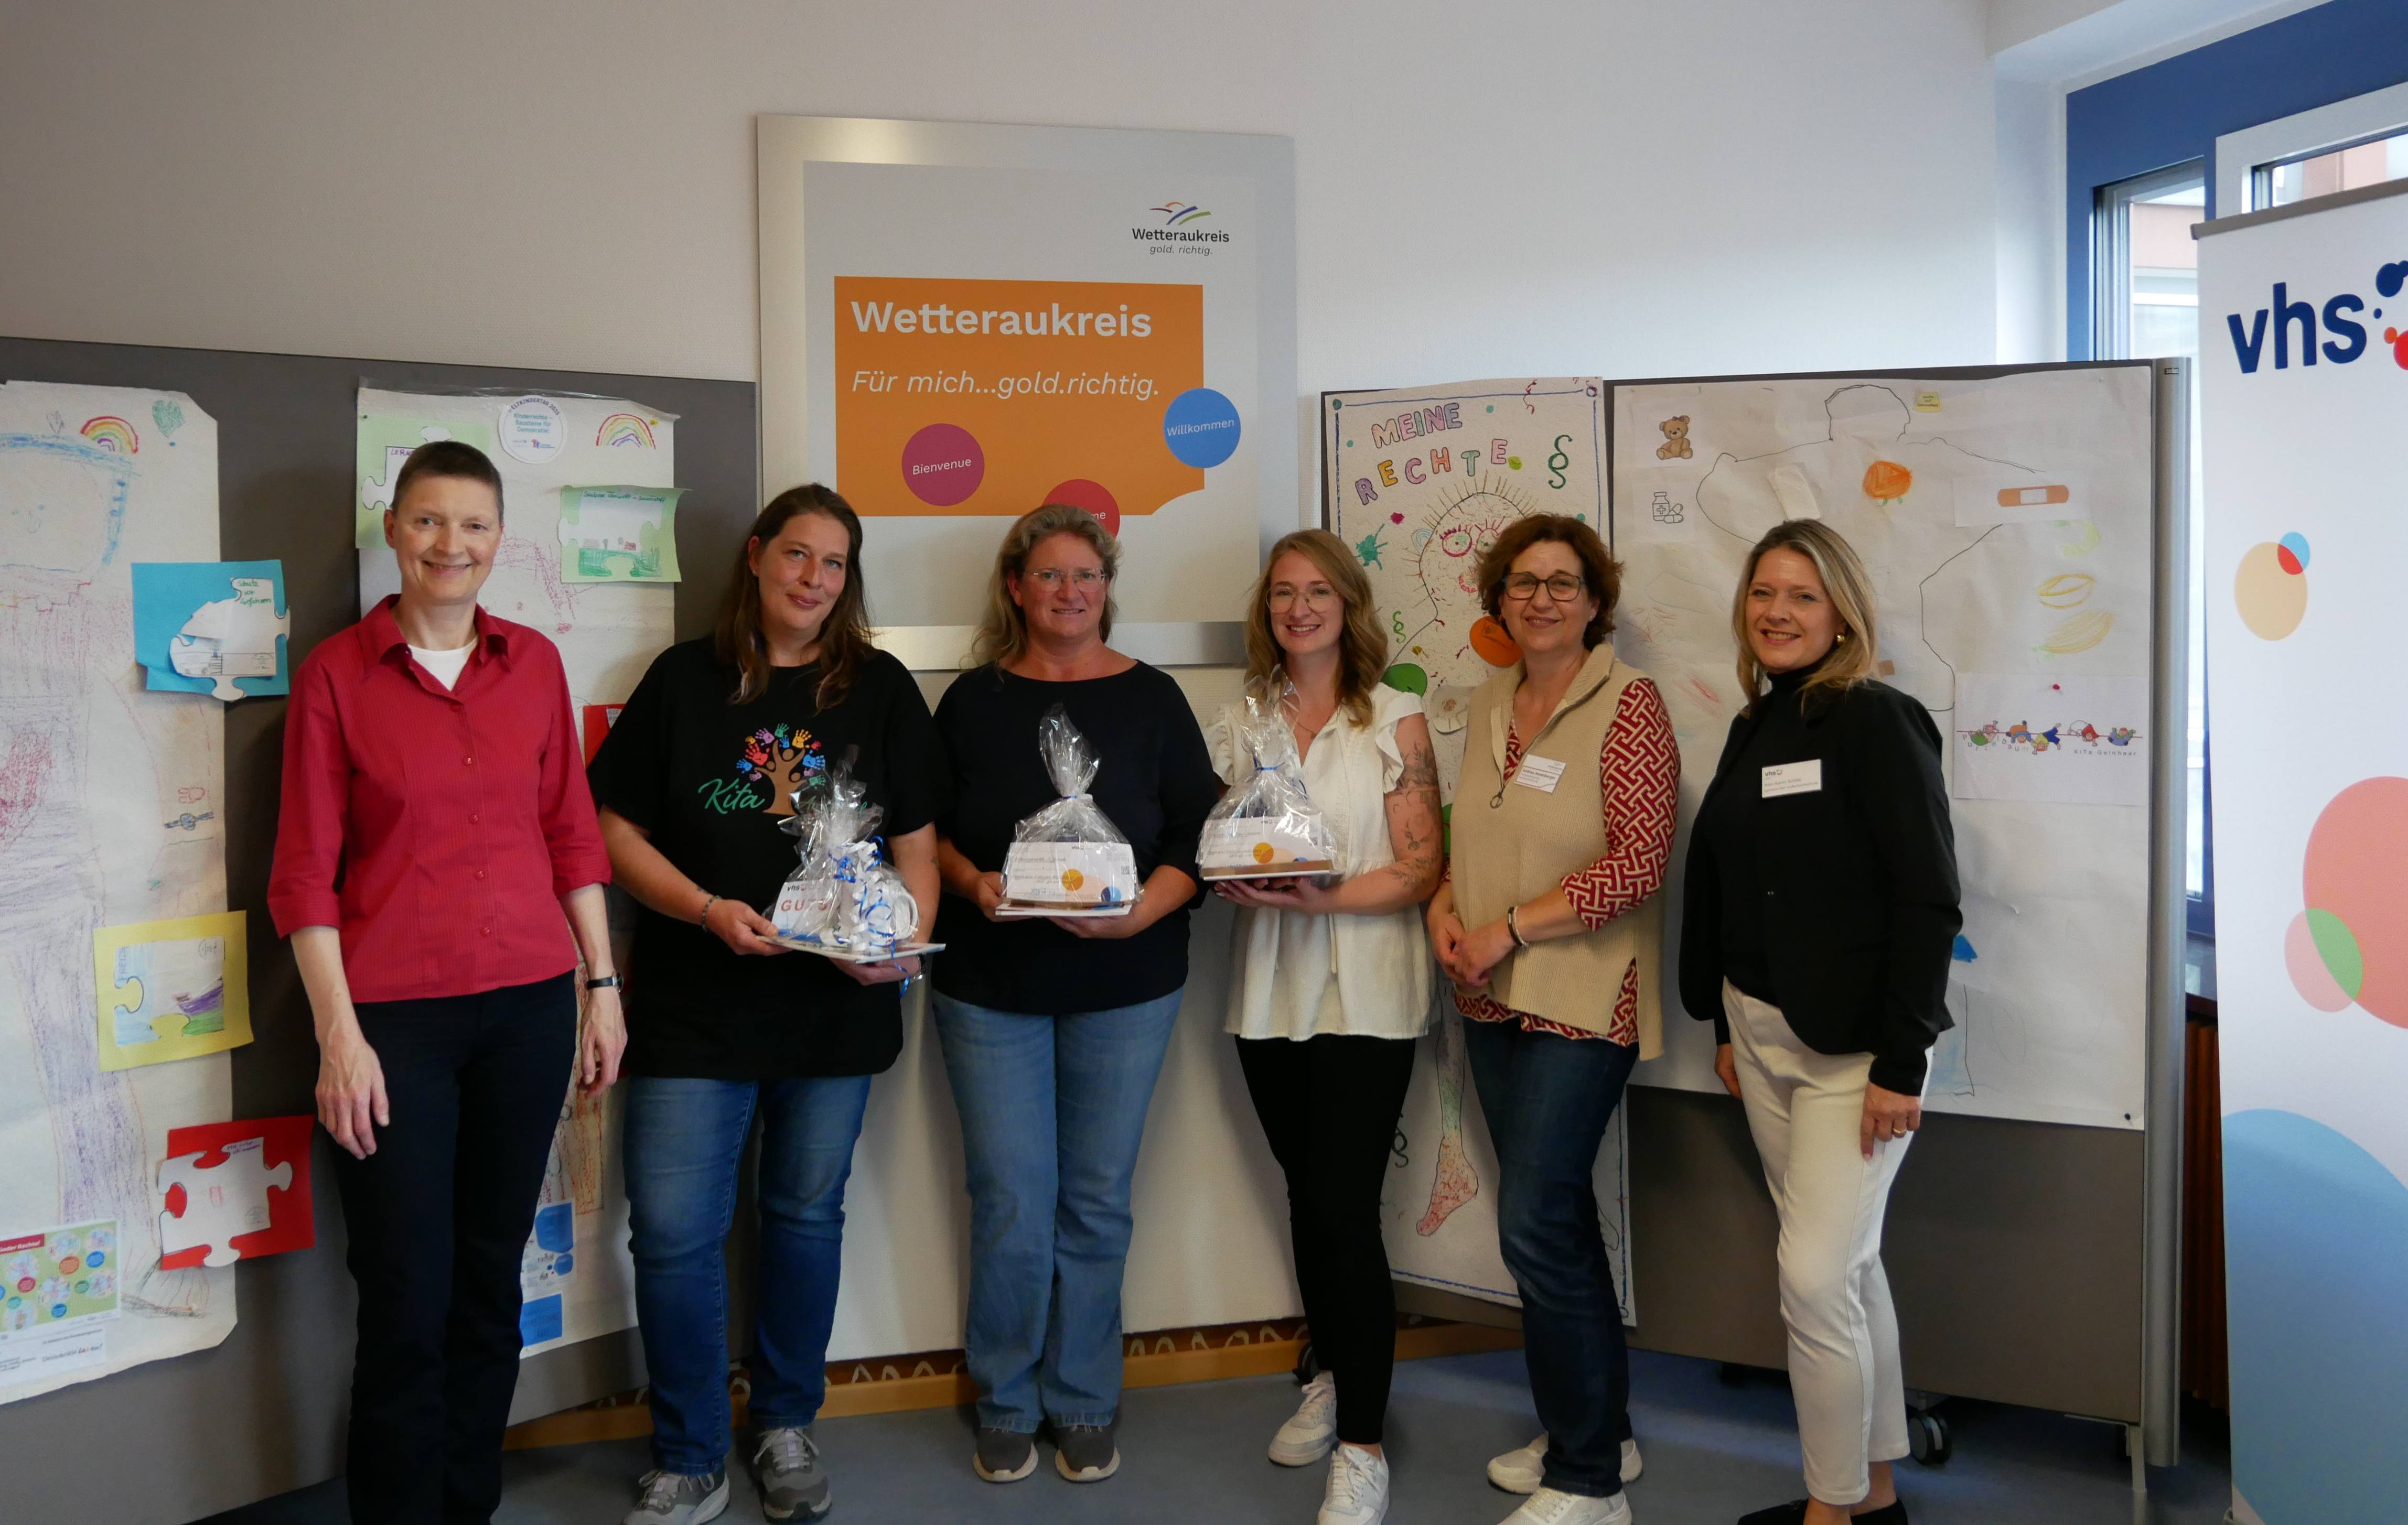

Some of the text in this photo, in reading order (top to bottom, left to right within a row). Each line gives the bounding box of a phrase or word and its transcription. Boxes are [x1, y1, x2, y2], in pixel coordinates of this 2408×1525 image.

[1132, 228, 1230, 242] Wetteraukreis
[1150, 245, 1212, 256] gold. richtig.
[851, 301, 1152, 338] Wetteraukreis
[2227, 282, 2367, 374] vhs
[852, 370, 898, 393] Für
[1166, 419, 1234, 438] Willkommen
[1371, 402, 1463, 449] MEINE
[912, 457, 972, 475] Bienvenue
[1354, 438, 1508, 505] RECHTE
[698, 778, 765, 815] Kita
